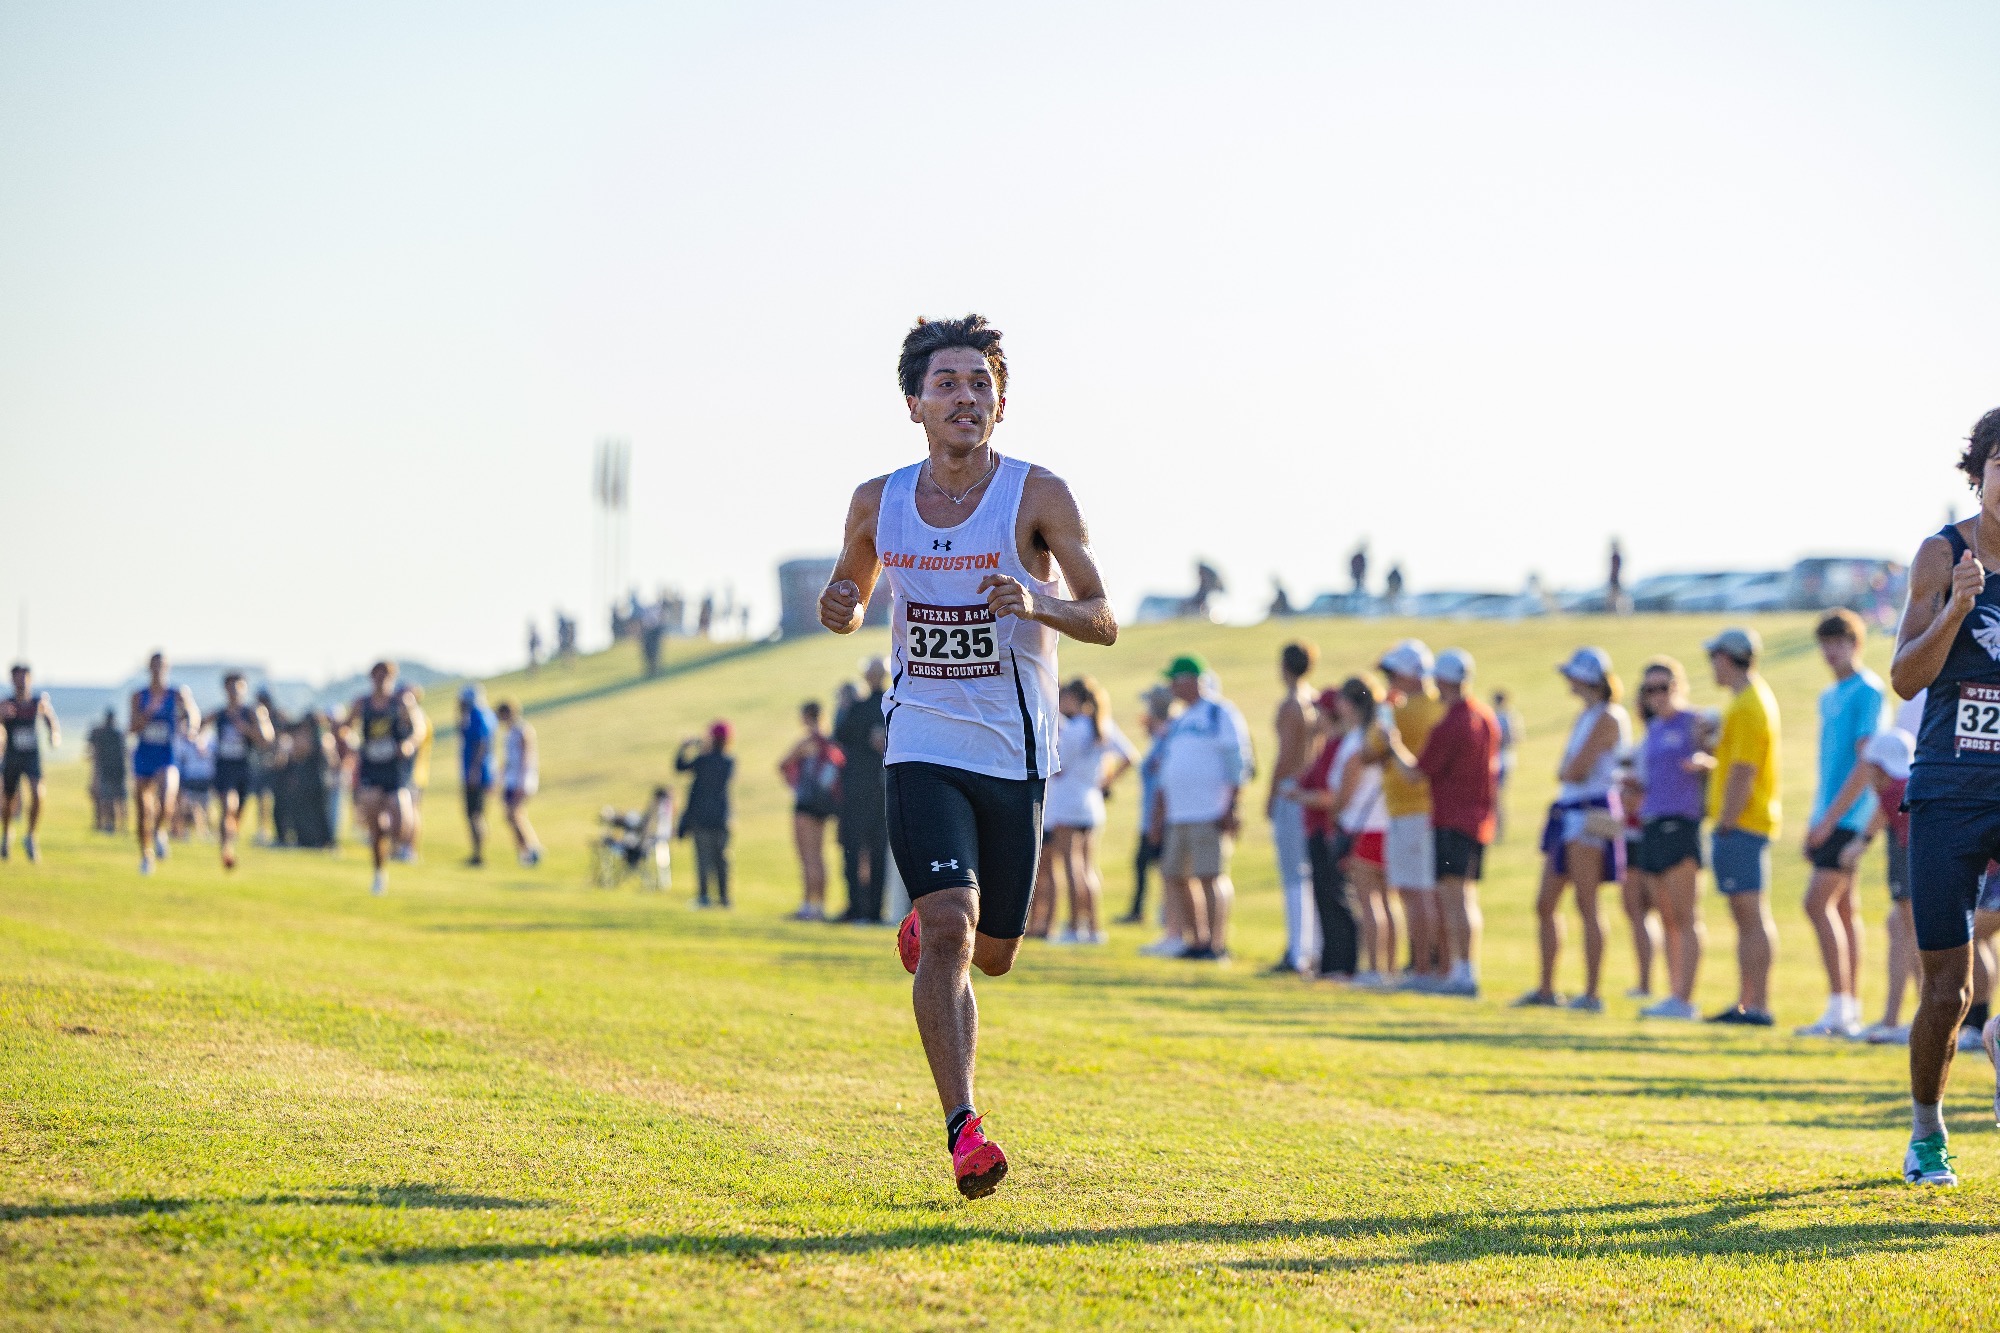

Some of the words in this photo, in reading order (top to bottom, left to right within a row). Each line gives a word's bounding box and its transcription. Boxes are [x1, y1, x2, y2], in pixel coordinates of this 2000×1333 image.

[883, 551, 916, 569] SAM
[918, 552, 1000, 571] HOUSTON
[921, 608, 959, 622] TEXAS
[965, 608, 990, 621] A&M
[910, 625, 994, 660] 3235
[912, 664, 943, 677] CROSS
[946, 664, 996, 677] COUNTRY
[1961, 703, 2000, 734] 32
[1960, 737, 1991, 751] CROSS
